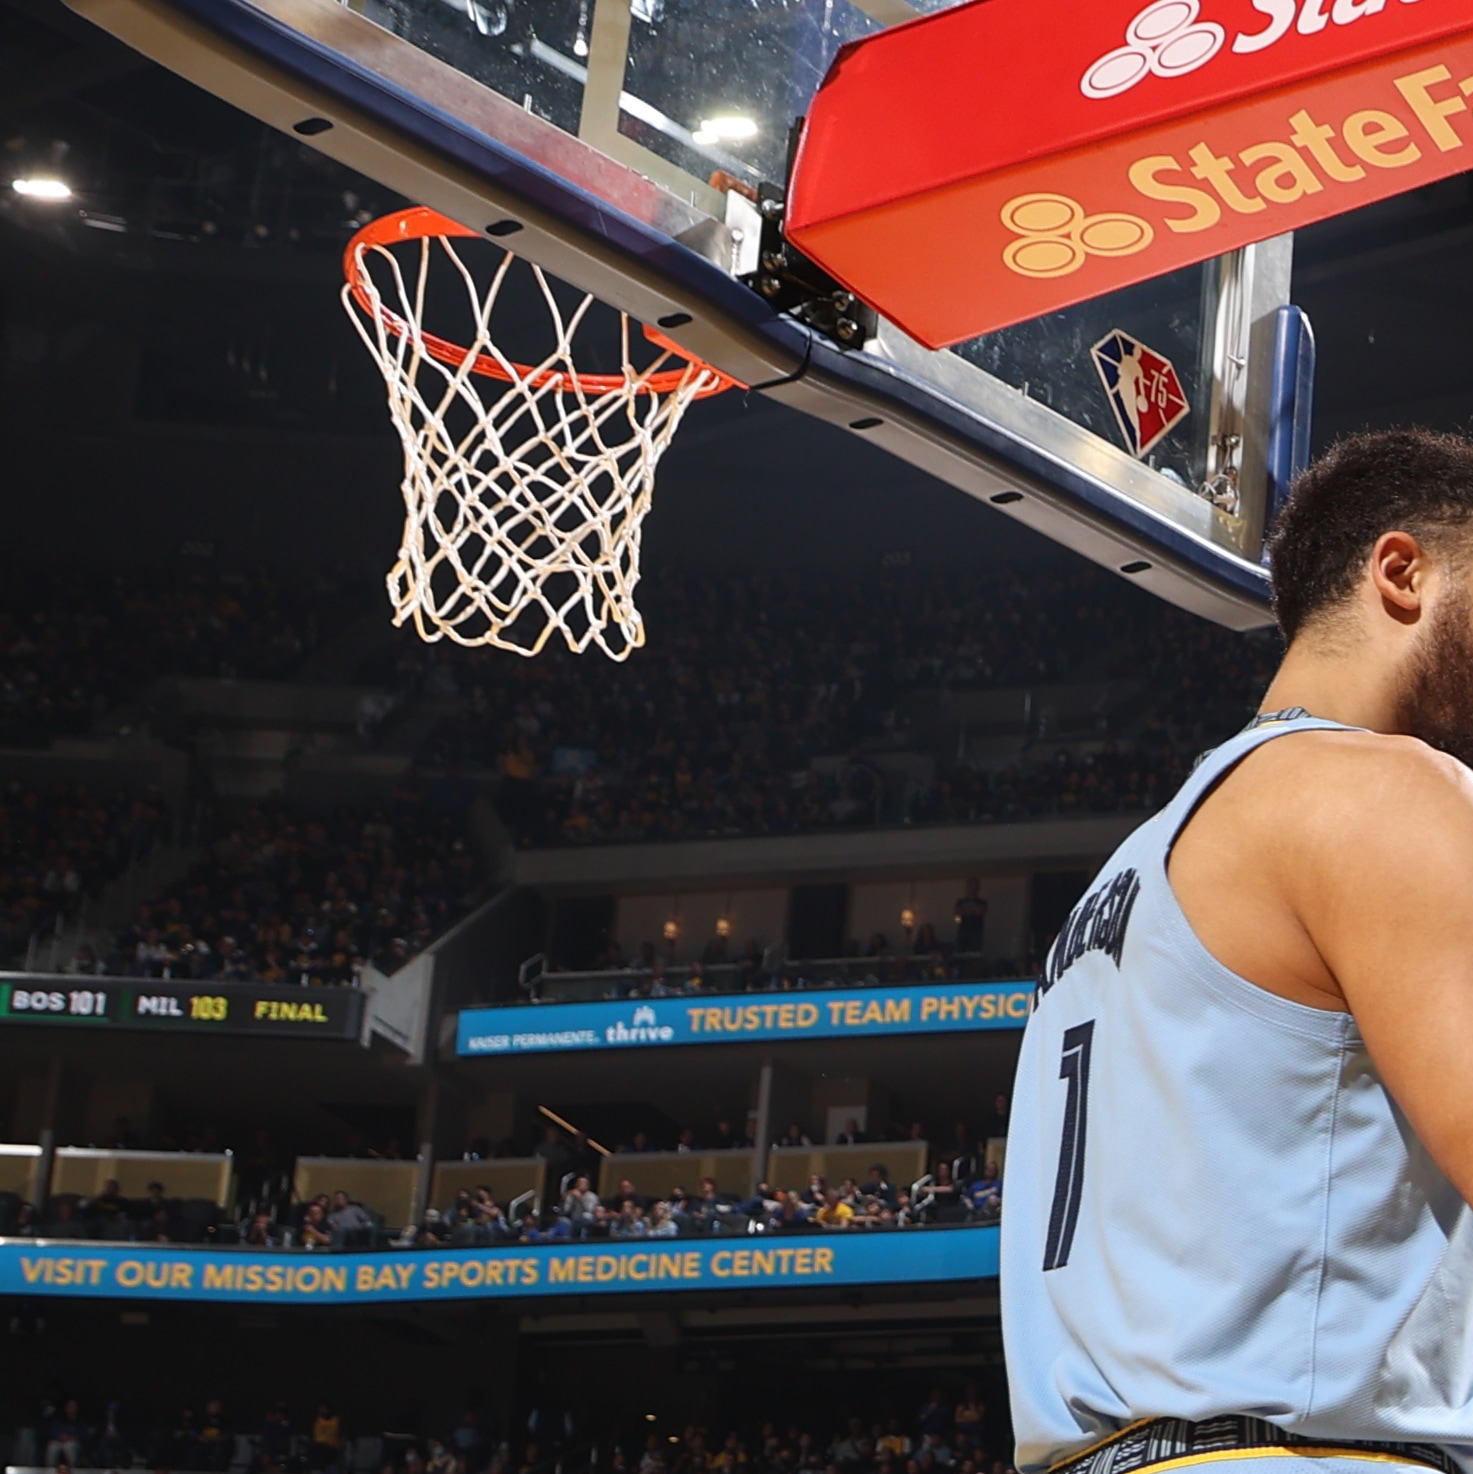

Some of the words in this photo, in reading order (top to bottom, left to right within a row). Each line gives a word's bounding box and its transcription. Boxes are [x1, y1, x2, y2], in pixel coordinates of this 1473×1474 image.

[12, 990, 66, 1012] BOS
[69, 989, 106, 1016] 101
[138, 995, 183, 1018] MIL
[190, 996, 227, 1021] 103
[254, 1000, 329, 1023] FINAL
[687, 1001, 819, 1033] TRUSTED
[826, 997, 912, 1027] TEAM
[468, 1032, 509, 1051] KAISER
[605, 1021, 674, 1043] thrive
[1042, 1018, 1096, 1272] 1
[20, 1255, 106, 1287] VISIT
[115, 1257, 192, 1290] OUR
[202, 1261, 347, 1294] MISSION
[354, 1261, 418, 1293] BAY
[422, 1255, 541, 1289] SPORTS
[546, 1250, 704, 1286] MEDICINE
[709, 1246, 835, 1278] CENTER
